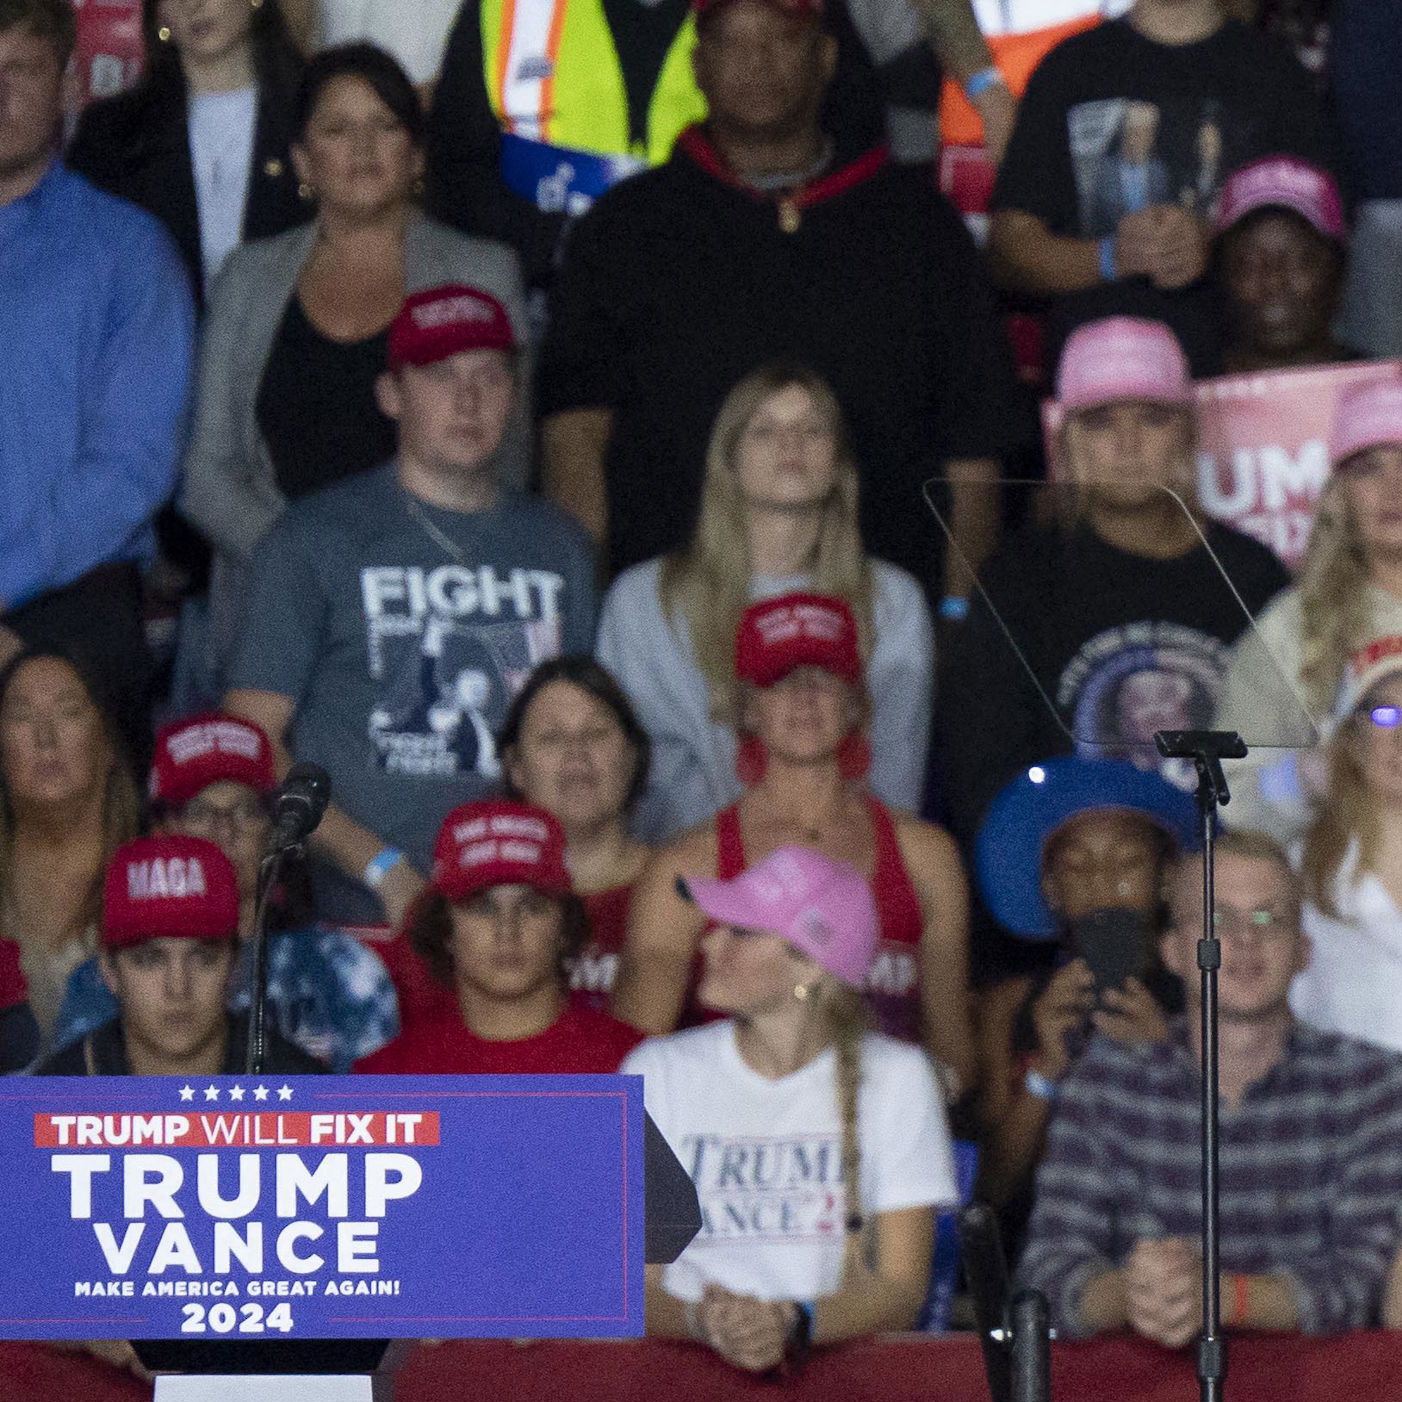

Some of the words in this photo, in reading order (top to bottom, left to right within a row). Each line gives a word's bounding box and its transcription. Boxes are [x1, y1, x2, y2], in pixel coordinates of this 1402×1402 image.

[1197, 439, 1330, 518] UM
[360, 563, 566, 622] FIGHT
[126, 856, 208, 898] MAGA
[50, 1114, 191, 1145] TRUMP
[200, 1114, 298, 1145] WILL
[309, 1113, 375, 1144] FIX
[384, 1112, 424, 1143] IT
[681, 1132, 848, 1190] TRUM
[50, 1152, 424, 1220] TRUMP
[702, 1198, 802, 1241] ANCE
[92, 1221, 381, 1275] VANCE
[74, 1281, 134, 1297] MAKE
[142, 1280, 239, 1297] AMERICA
[246, 1280, 317, 1297] GREAT
[324, 1279, 401, 1296] AGAIN!
[180, 1302, 295, 1334] 2024
